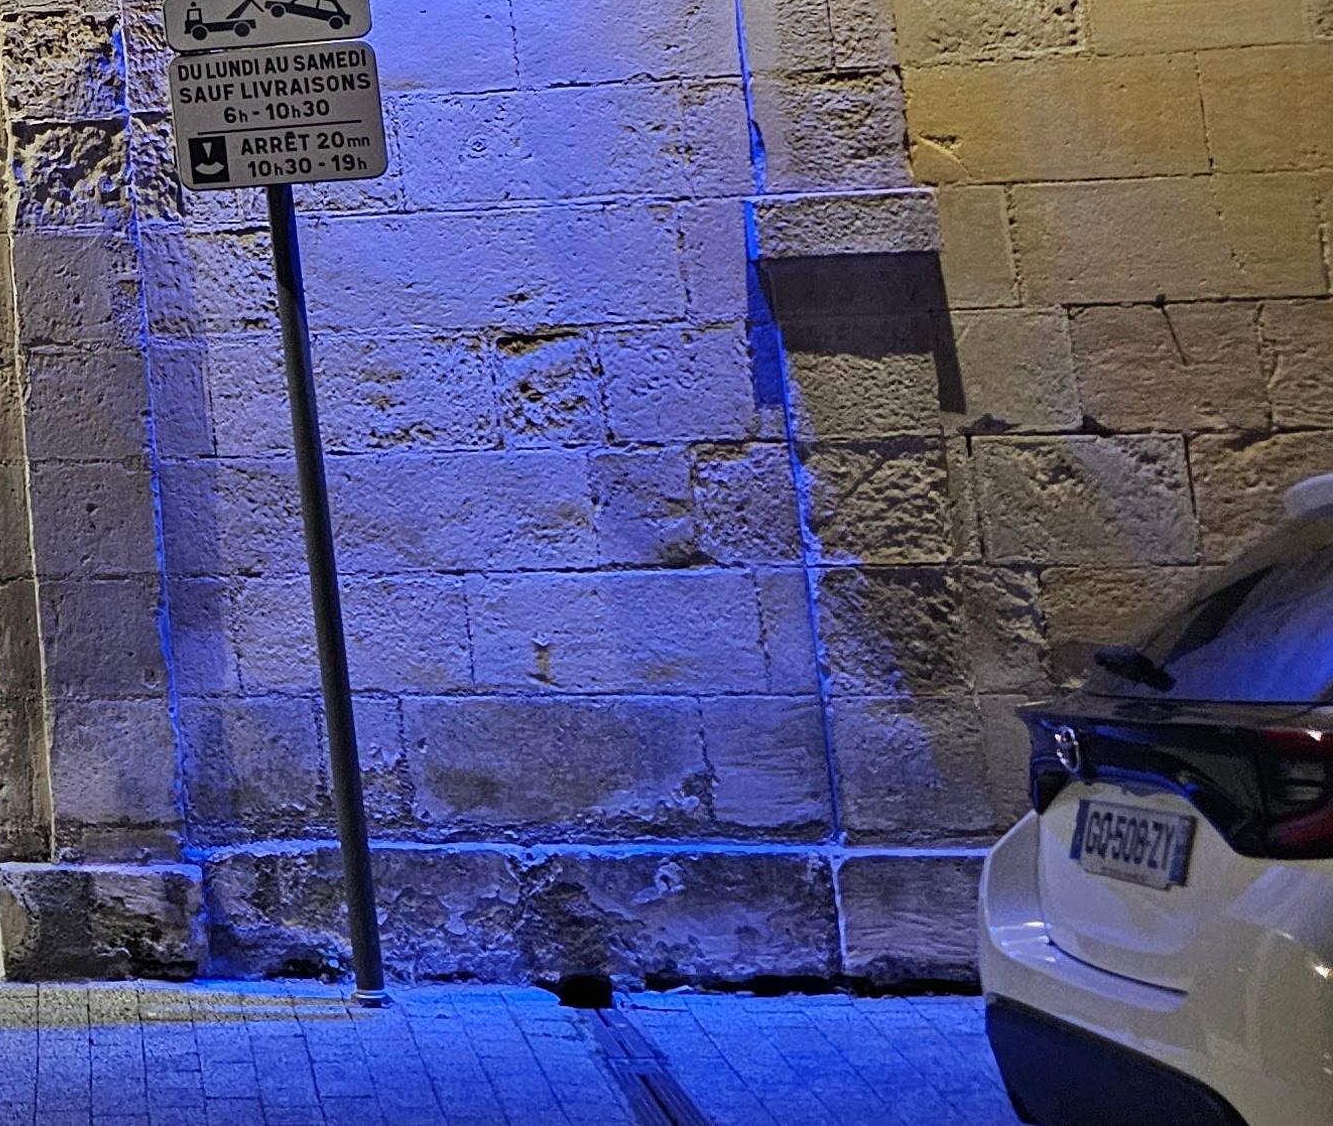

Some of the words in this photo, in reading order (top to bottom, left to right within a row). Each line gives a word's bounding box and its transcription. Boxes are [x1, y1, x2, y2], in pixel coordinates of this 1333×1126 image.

[177, 64, 202, 82] DU
[205, 58, 260, 79] LUNDI
[264, 55, 289, 74] AU
[294, 49, 367, 71] SAMEDI
[179, 83, 235, 105] SAUF
[241, 72, 371, 100] LIVRAISONS
[223, 106, 248, 124] 6h
[265, 99, 330, 121] 10h30
[240, 132, 310, 156] ARRÊT
[247, 156, 312, 178] 10h30
[331, 154, 368, 172] 19h
